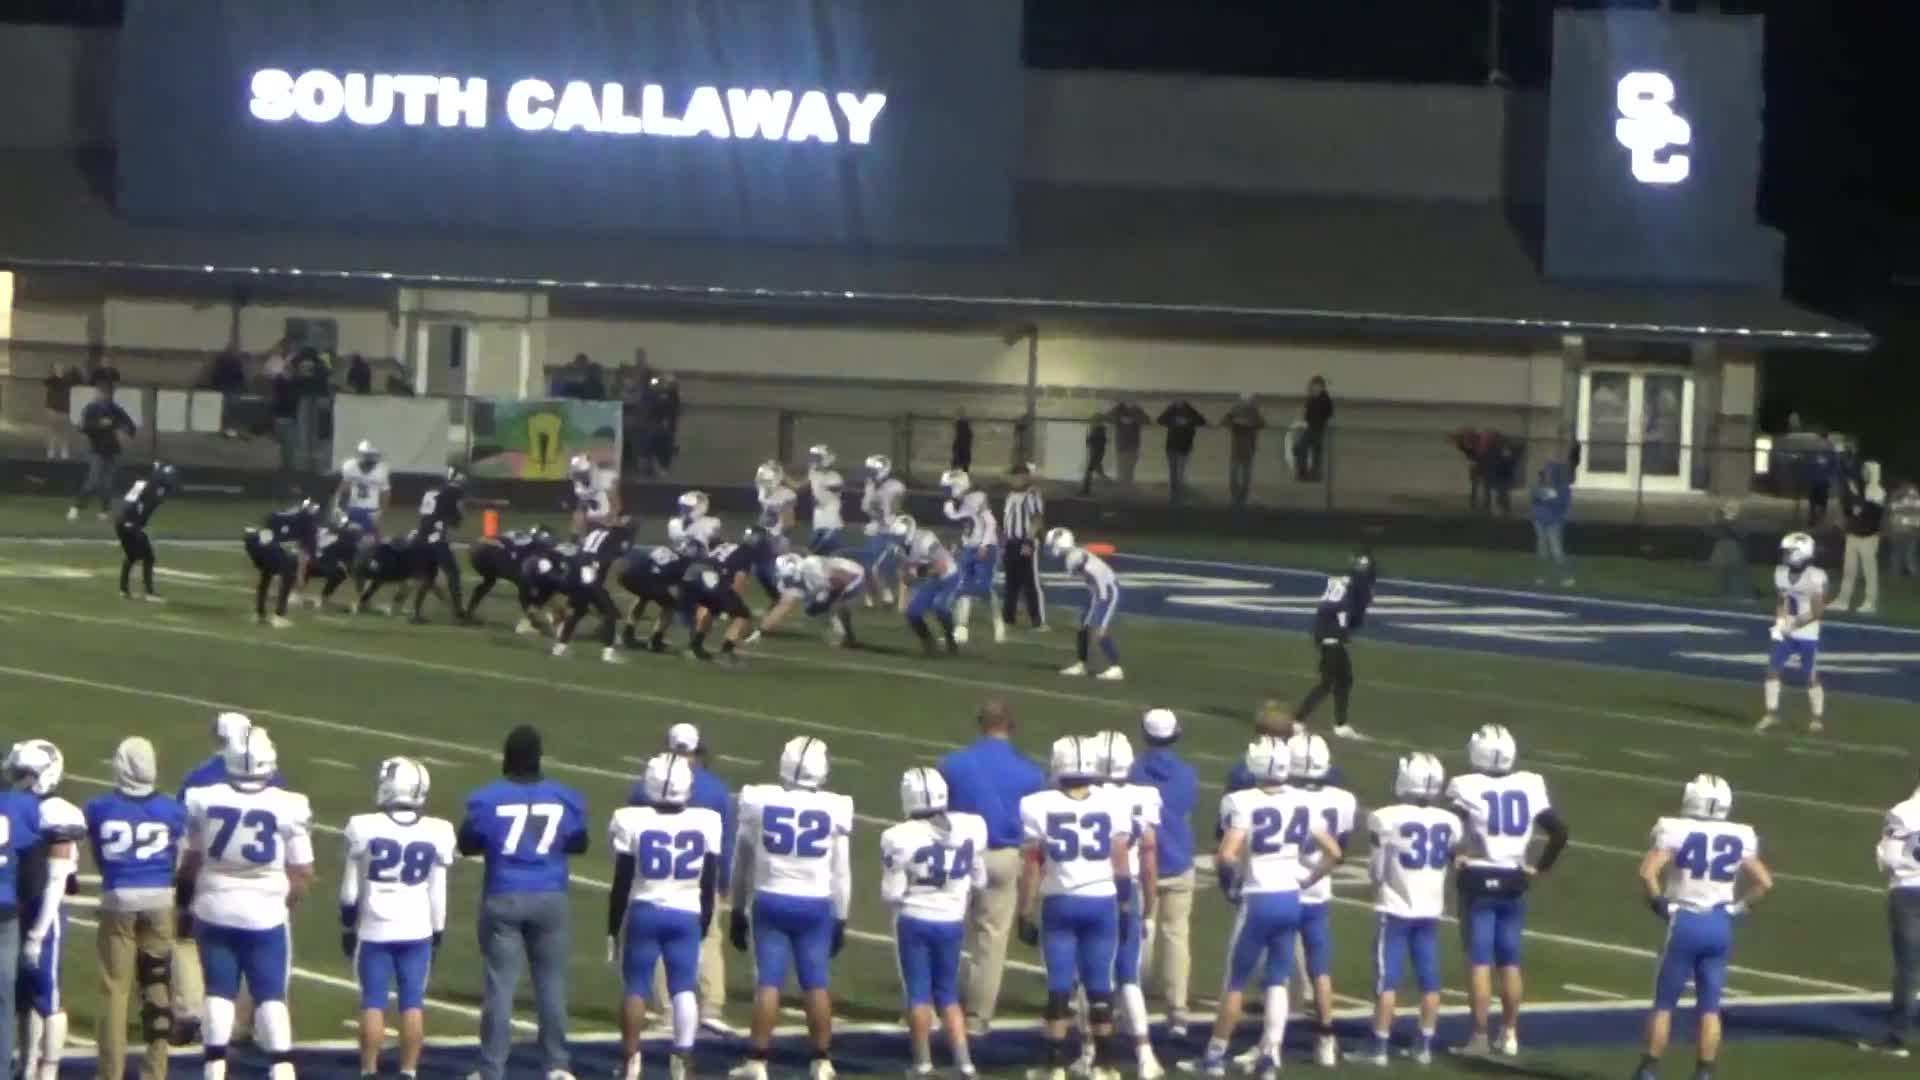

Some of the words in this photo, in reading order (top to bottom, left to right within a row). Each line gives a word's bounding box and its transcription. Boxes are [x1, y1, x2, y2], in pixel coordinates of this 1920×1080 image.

[249, 68, 488, 128] SOUTH
[506, 79, 887, 144] CALLAWAY
[1615, 71, 1691, 183] SC
[206, 805, 278, 864] 73
[495, 803, 564, 856] 77
[761, 804, 832, 858] 52
[1046, 811, 1112, 862] 53
[1251, 806, 1311, 853] 24
[1480, 789, 1530, 836] 10
[100, 819, 169, 862] 22
[367, 836, 437, 886] 28
[638, 829, 705, 881] 62
[1399, 821, 1454, 870] 38
[1675, 831, 1743, 882] 42
